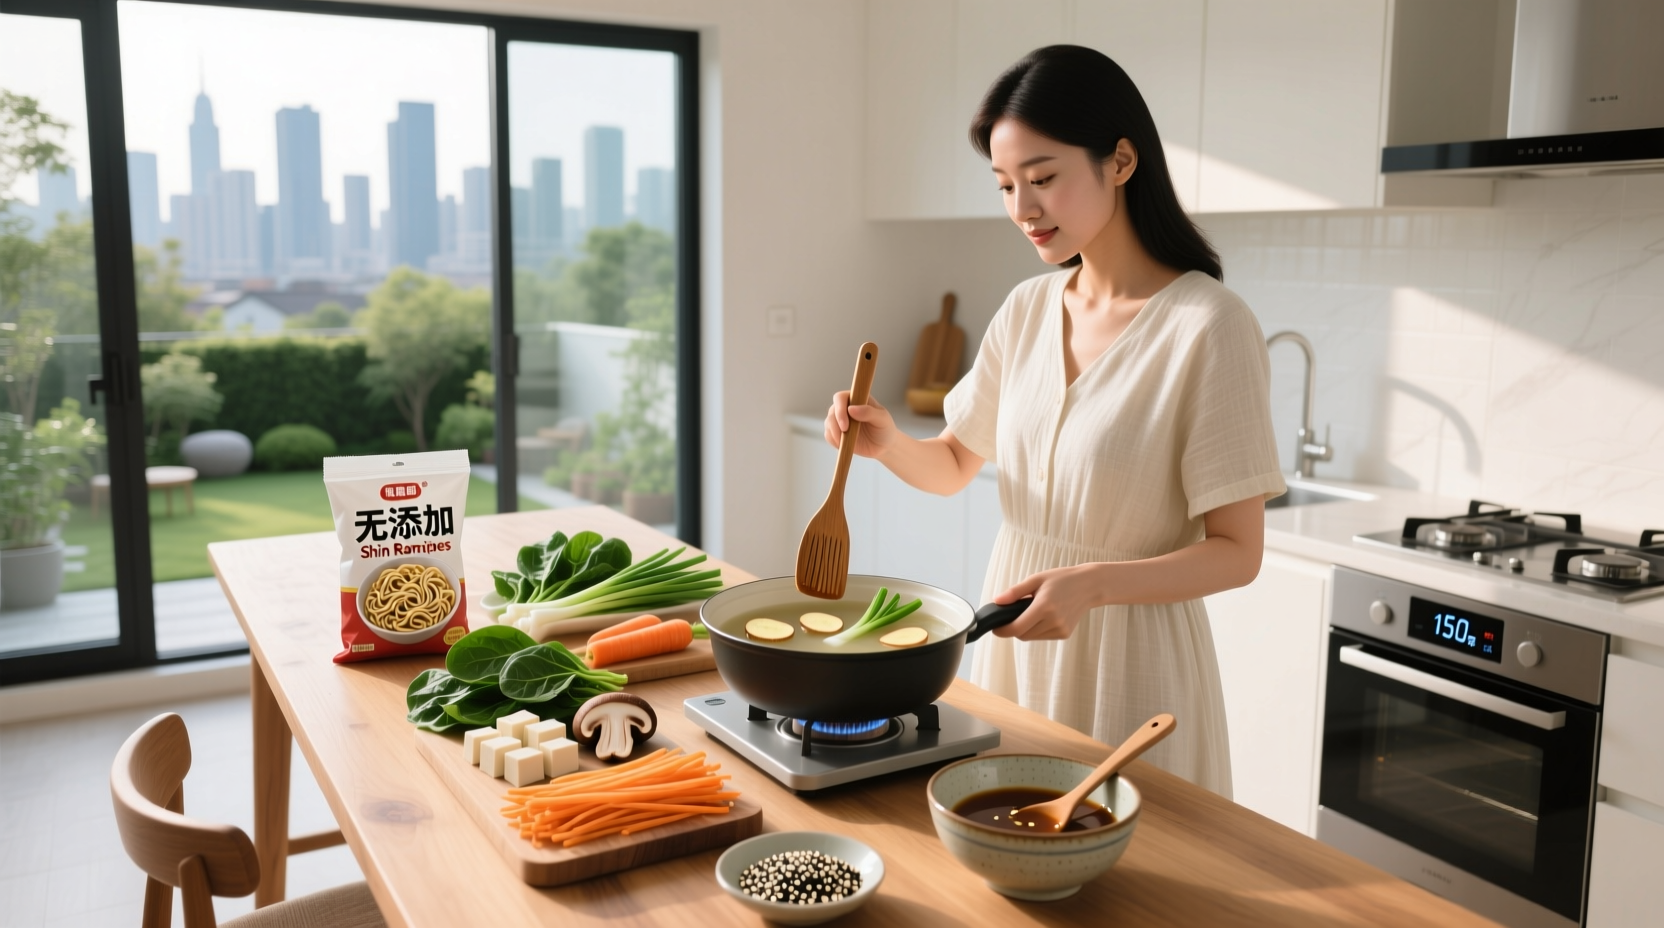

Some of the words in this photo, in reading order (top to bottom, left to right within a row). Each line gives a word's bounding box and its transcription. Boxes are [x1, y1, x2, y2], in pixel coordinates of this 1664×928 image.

[355, 504, 454, 543] 无添加
[361, 544, 390, 559] Shin
